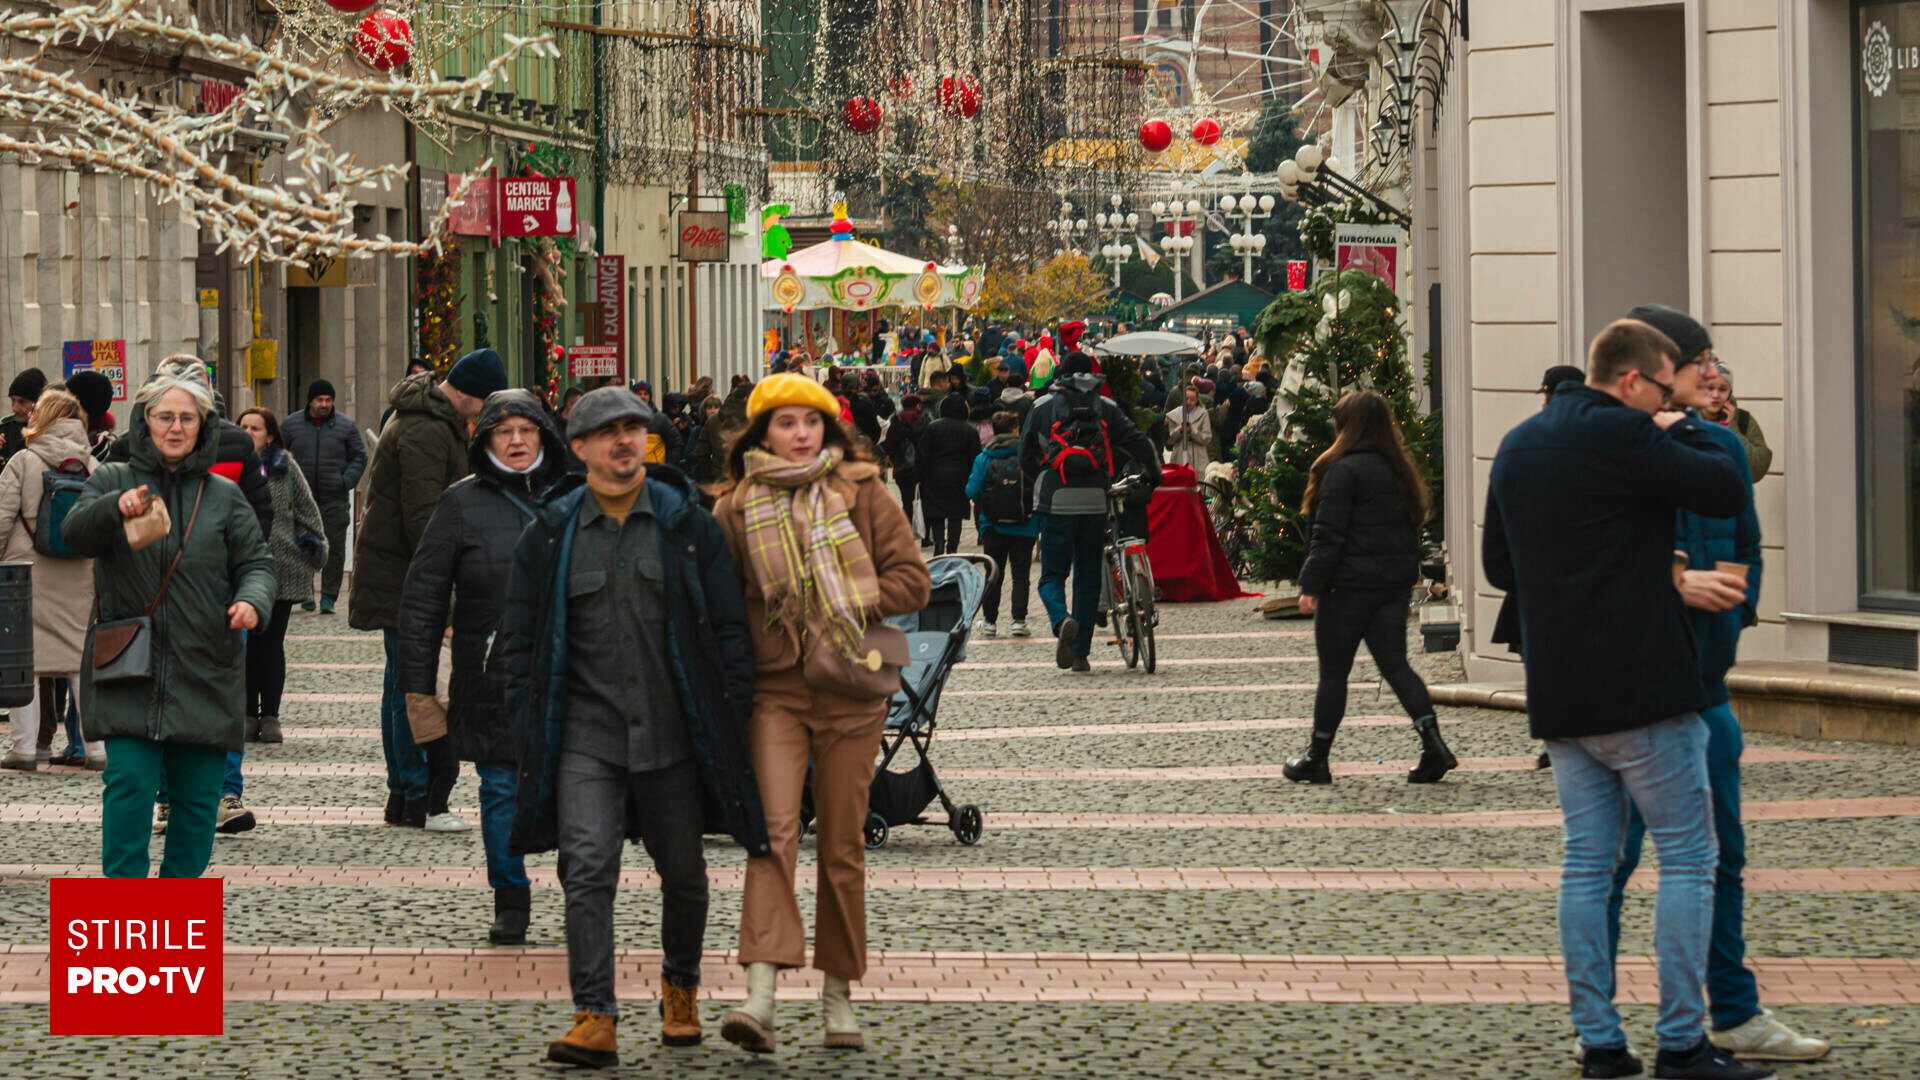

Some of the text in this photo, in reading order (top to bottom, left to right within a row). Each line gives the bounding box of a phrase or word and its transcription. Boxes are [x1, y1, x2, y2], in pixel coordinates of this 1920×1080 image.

[505, 181, 552, 196] CENTRAL
[507, 196, 551, 211] MARKET
[1338, 235, 1397, 244] EUROTHALIA
[601, 258, 618, 335] EXCHANGE
[65, 351, 121, 363] VALUTAR
